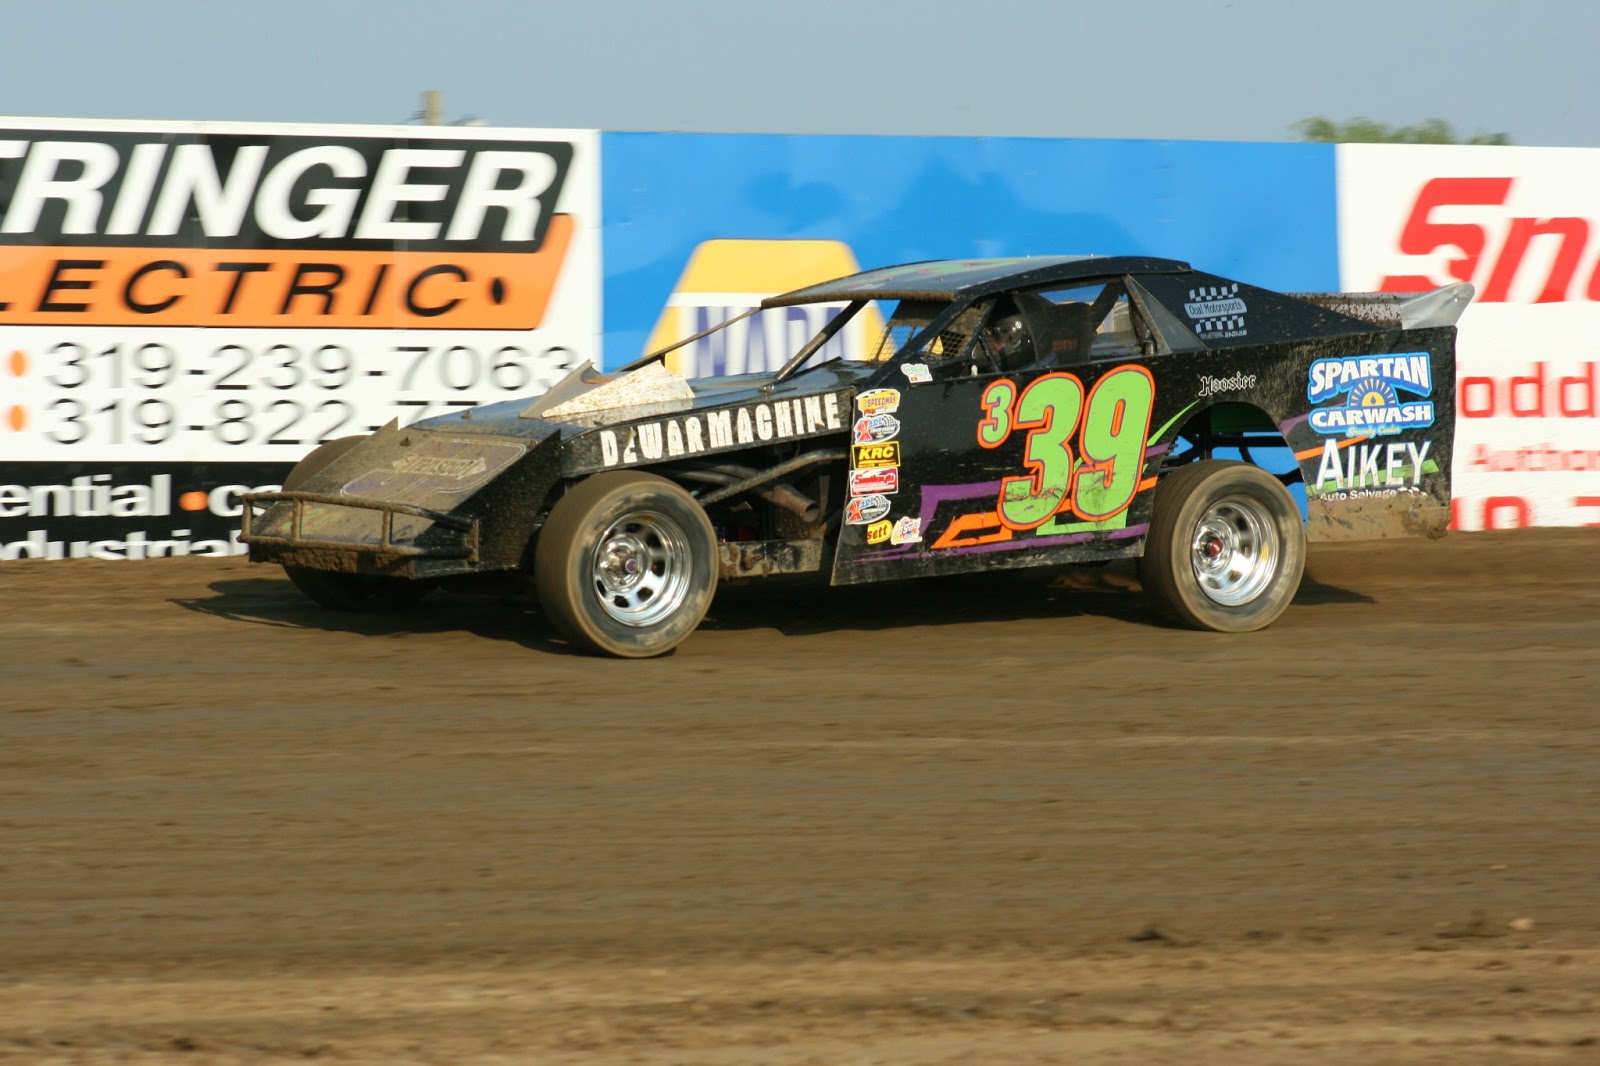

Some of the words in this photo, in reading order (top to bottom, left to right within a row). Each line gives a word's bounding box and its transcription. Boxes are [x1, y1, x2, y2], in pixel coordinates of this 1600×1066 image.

[0, 140, 557, 243] RINGER
[1379, 176, 1600, 304] Sn
[0, 259, 471, 317] ECTRIC
[1204, 301, 1243, 314] Motorsports
[44, 341, 577, 391] 319-239-7063
[1198, 370, 1257, 397] Hoosier
[1310, 355, 1429, 396] SPARTAN
[1455, 360, 1600, 418] odd
[44, 398, 481, 446] 319-822-7
[1311, 405, 1432, 427] CARWASH
[858, 446, 895, 460] KRC
[996, 363, 1156, 531] 39
[1315, 439, 1432, 491] AIKEY
[0, 473, 172, 518] ential
[1350, 489, 1397, 500] Salvage
[0, 529, 249, 560] dustrial
[867, 524, 887, 540] sett
